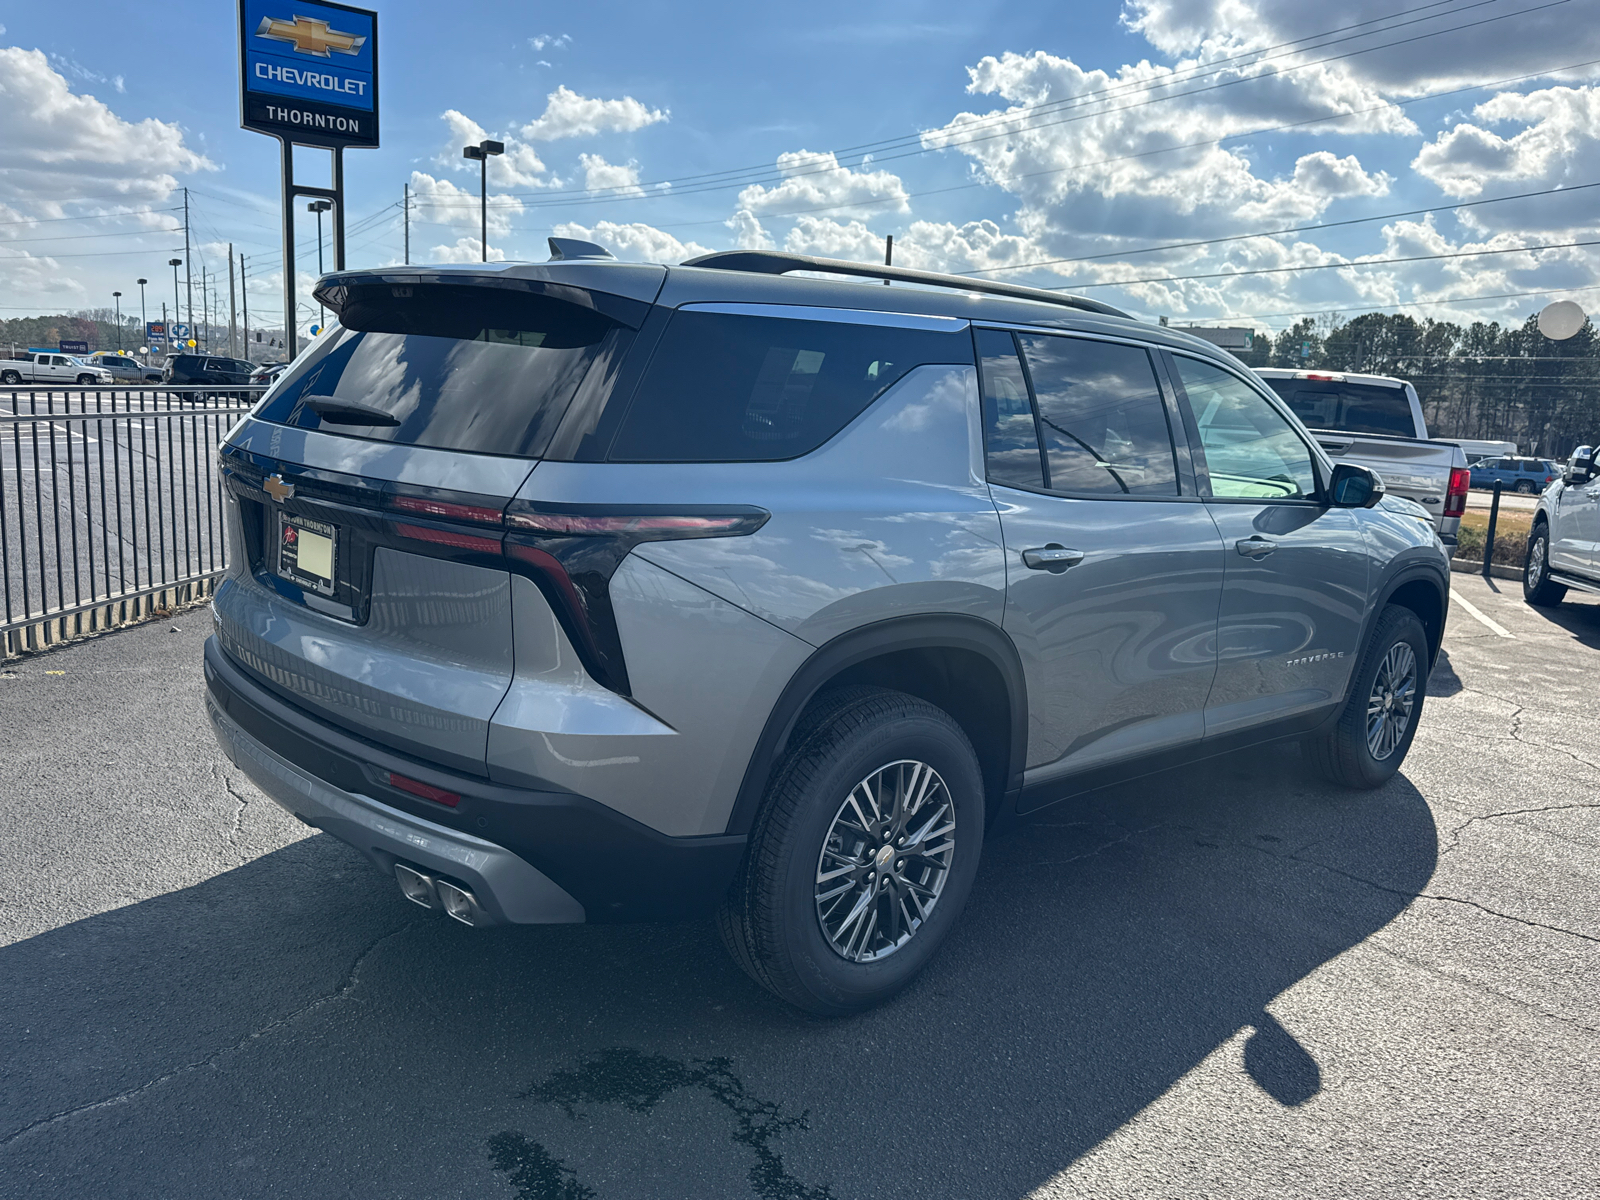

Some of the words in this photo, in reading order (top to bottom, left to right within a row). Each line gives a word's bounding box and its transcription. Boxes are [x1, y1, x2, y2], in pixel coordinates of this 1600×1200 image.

[255, 62, 367, 96] CHEVROLET
[266, 105, 359, 133] THORNTON
[1286, 651, 1344, 668] TRAVERSE
